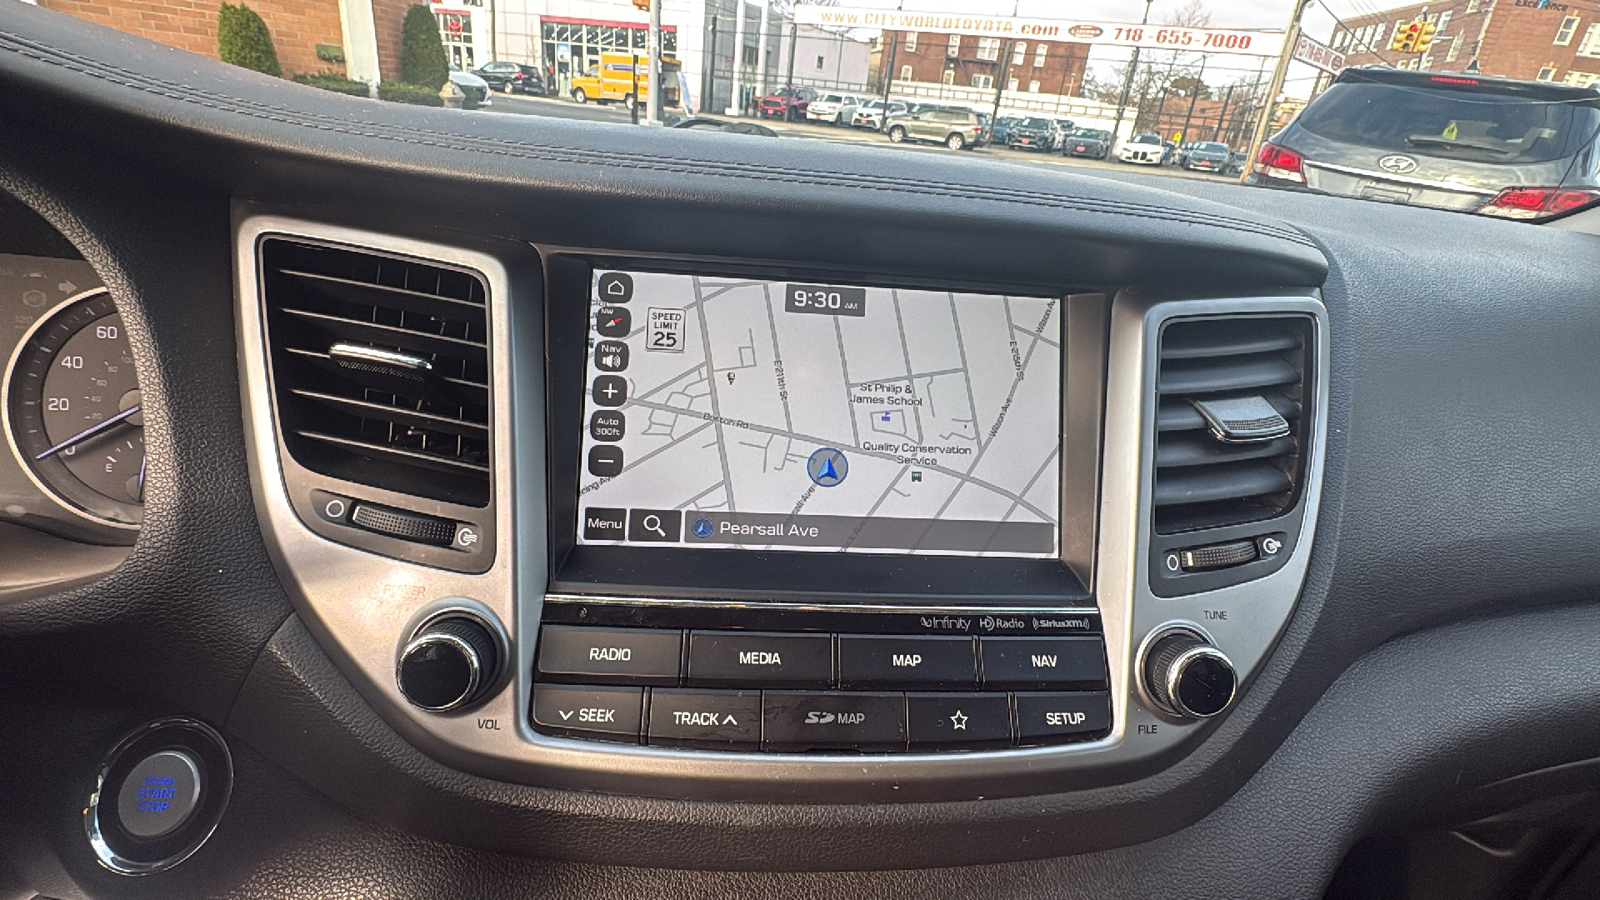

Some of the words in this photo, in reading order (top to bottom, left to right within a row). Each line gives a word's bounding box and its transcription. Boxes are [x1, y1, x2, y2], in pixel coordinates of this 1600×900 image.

[1515, 0, 1569, 12] Excelence
[794, 290, 841, 308] 9:30
[844, 302, 858, 310] AM
[652, 312, 682, 321] SPEED
[96, 326, 118, 339] 60
[654, 322, 679, 331] LIMIT
[653, 331, 677, 347] 25
[601, 344, 622, 353] Nav
[61, 356, 83, 369] 40
[1016, 371, 1025, 382] St
[860, 382, 873, 393] St
[874, 383, 903, 395] Philip
[905, 384, 913, 394] &
[780, 391, 789, 401] St
[850, 395, 885, 405] James
[887, 396, 923, 406] School
[48, 398, 69, 411] 20
[597, 417, 619, 425] Auto
[703, 412, 735, 427] Boston
[735, 419, 749, 429] Rd
[988, 412, 1005, 437] Wilson
[1001, 397, 1013, 413] Ave
[595, 427, 621, 436] 300ft
[863, 441, 900, 453] Quality
[902, 443, 972, 455] Conservation
[897, 455, 938, 466] Service
[105, 463, 113, 472] E
[588, 518, 623, 529] Menu
[720, 522, 784, 536] Pearsall
[788, 524, 819, 538] Ave
[1203, 610, 1228, 620] TUNE
[932, 616, 972, 632] Infinity
[996, 618, 1025, 629] Radio
[589, 647, 631, 661] RADIO
[739, 652, 781, 665] MEDIA
[893, 654, 922, 667] MAP
[1031, 655, 1058, 667] NAV
[579, 708, 615, 723] SEEK
[673, 711, 720, 726] TRACK
[837, 712, 866, 725] MAP
[1046, 712, 1086, 725] SETUP
[477, 718, 501, 731] VOL
[1137, 725, 1158, 734] FILE
[137, 787, 177, 799] START
[137, 801, 170, 813] STOP
